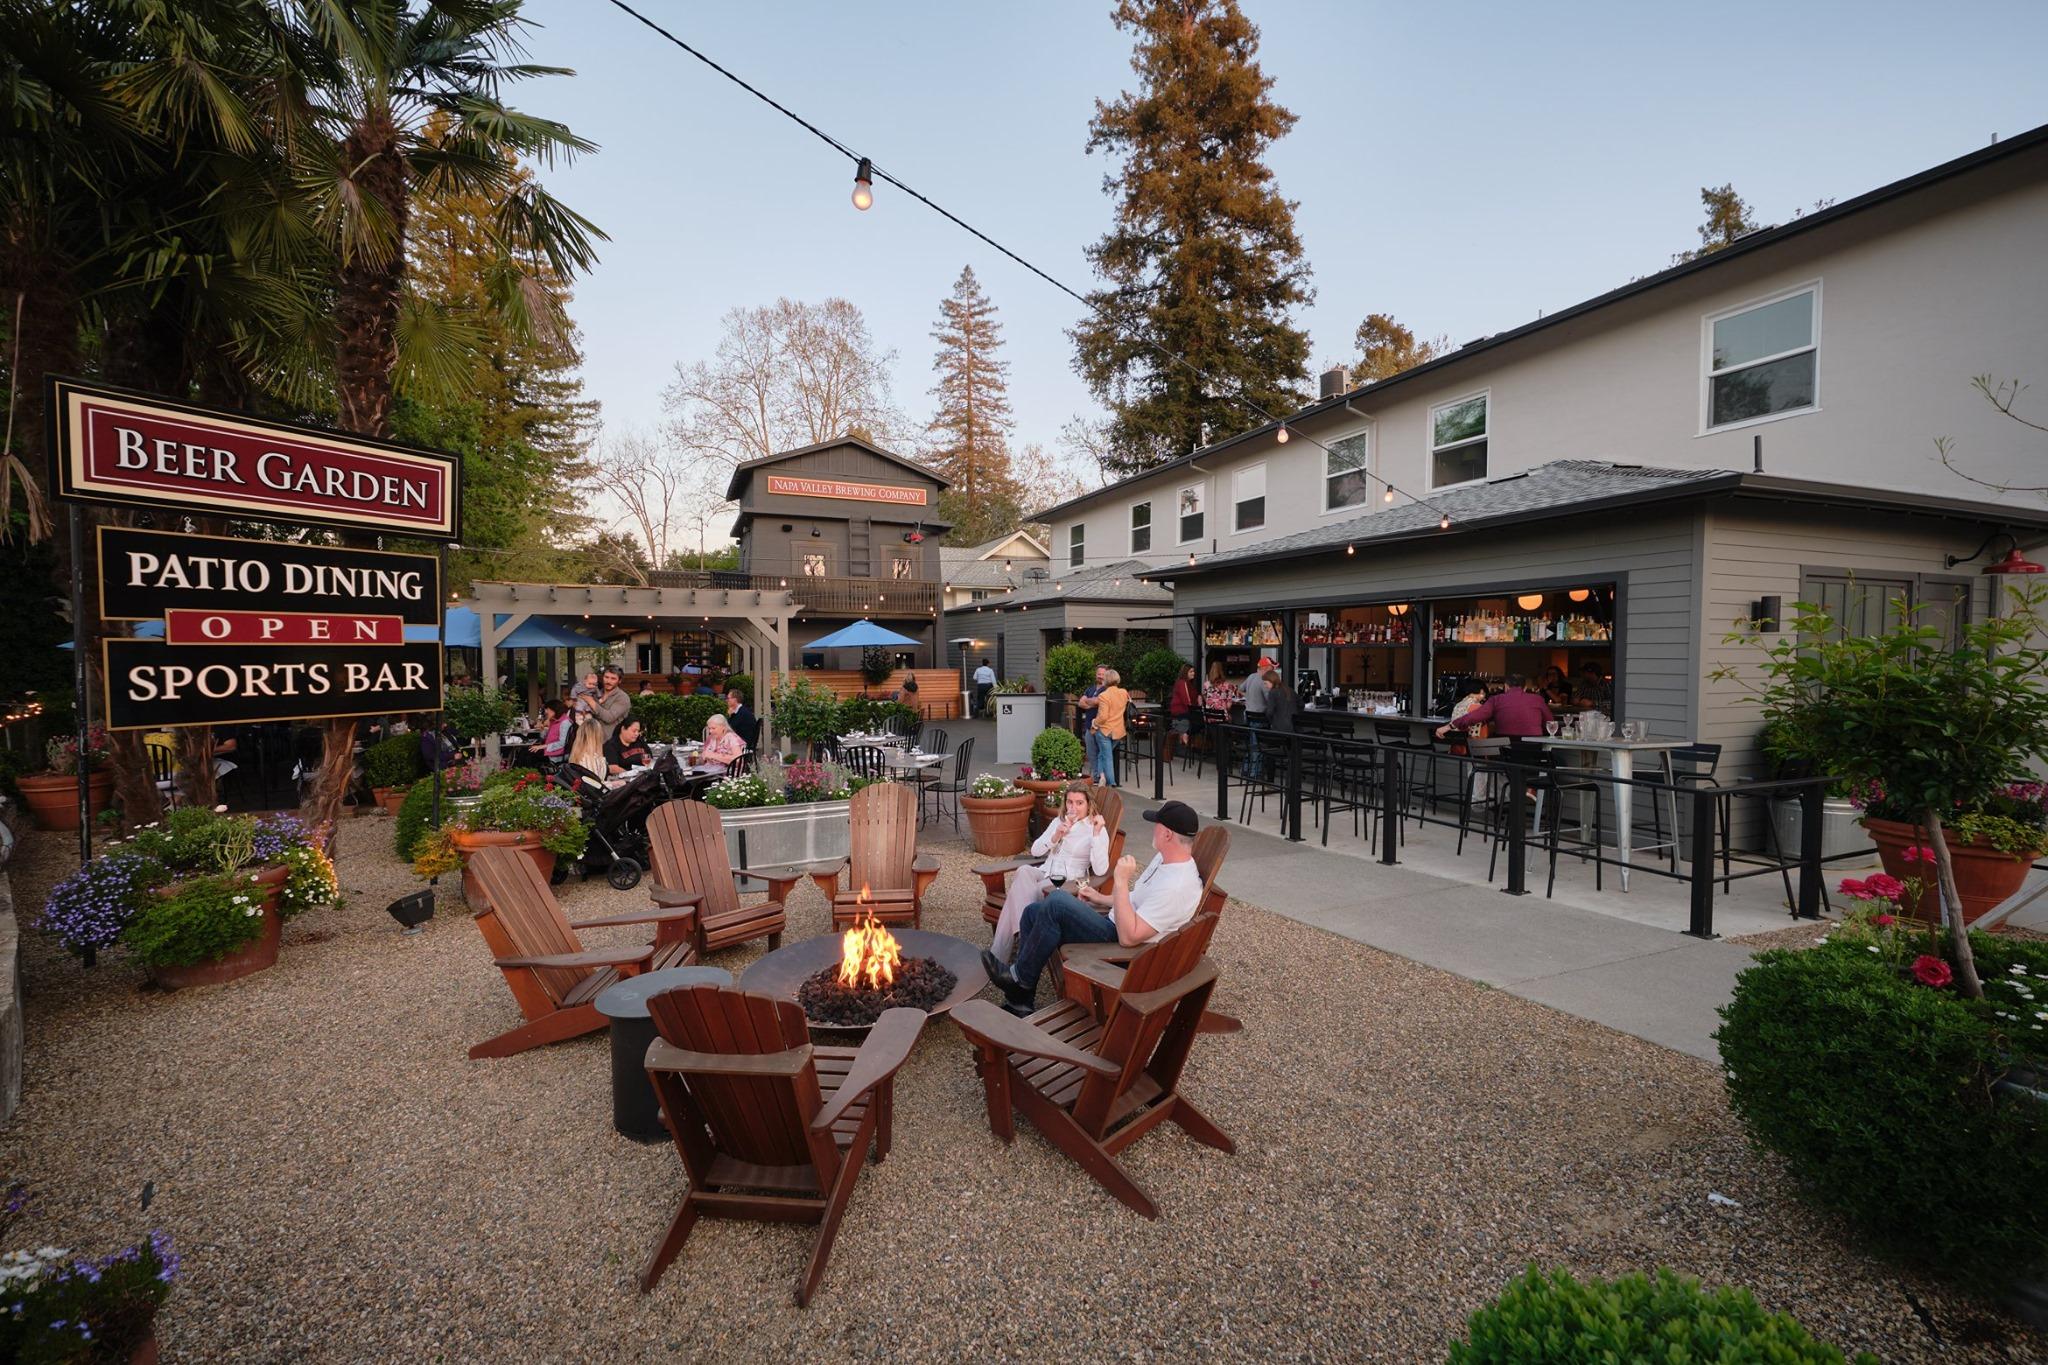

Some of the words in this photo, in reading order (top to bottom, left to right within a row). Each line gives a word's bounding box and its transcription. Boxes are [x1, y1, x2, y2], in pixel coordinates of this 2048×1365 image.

[113, 428, 245, 485] BEER
[256, 452, 429, 510] GARDEN
[774, 480, 798, 491] NAPA
[800, 482, 833, 493] VALLEY
[835, 485, 876, 497] BREWING
[878, 489, 920, 501] COMPANY
[126, 551, 271, 592] PATIO
[282, 562, 424, 600] DINING
[201, 616, 380, 640] OPEN
[128, 663, 331, 701] SPORTS
[344, 662, 430, 693] BAR
